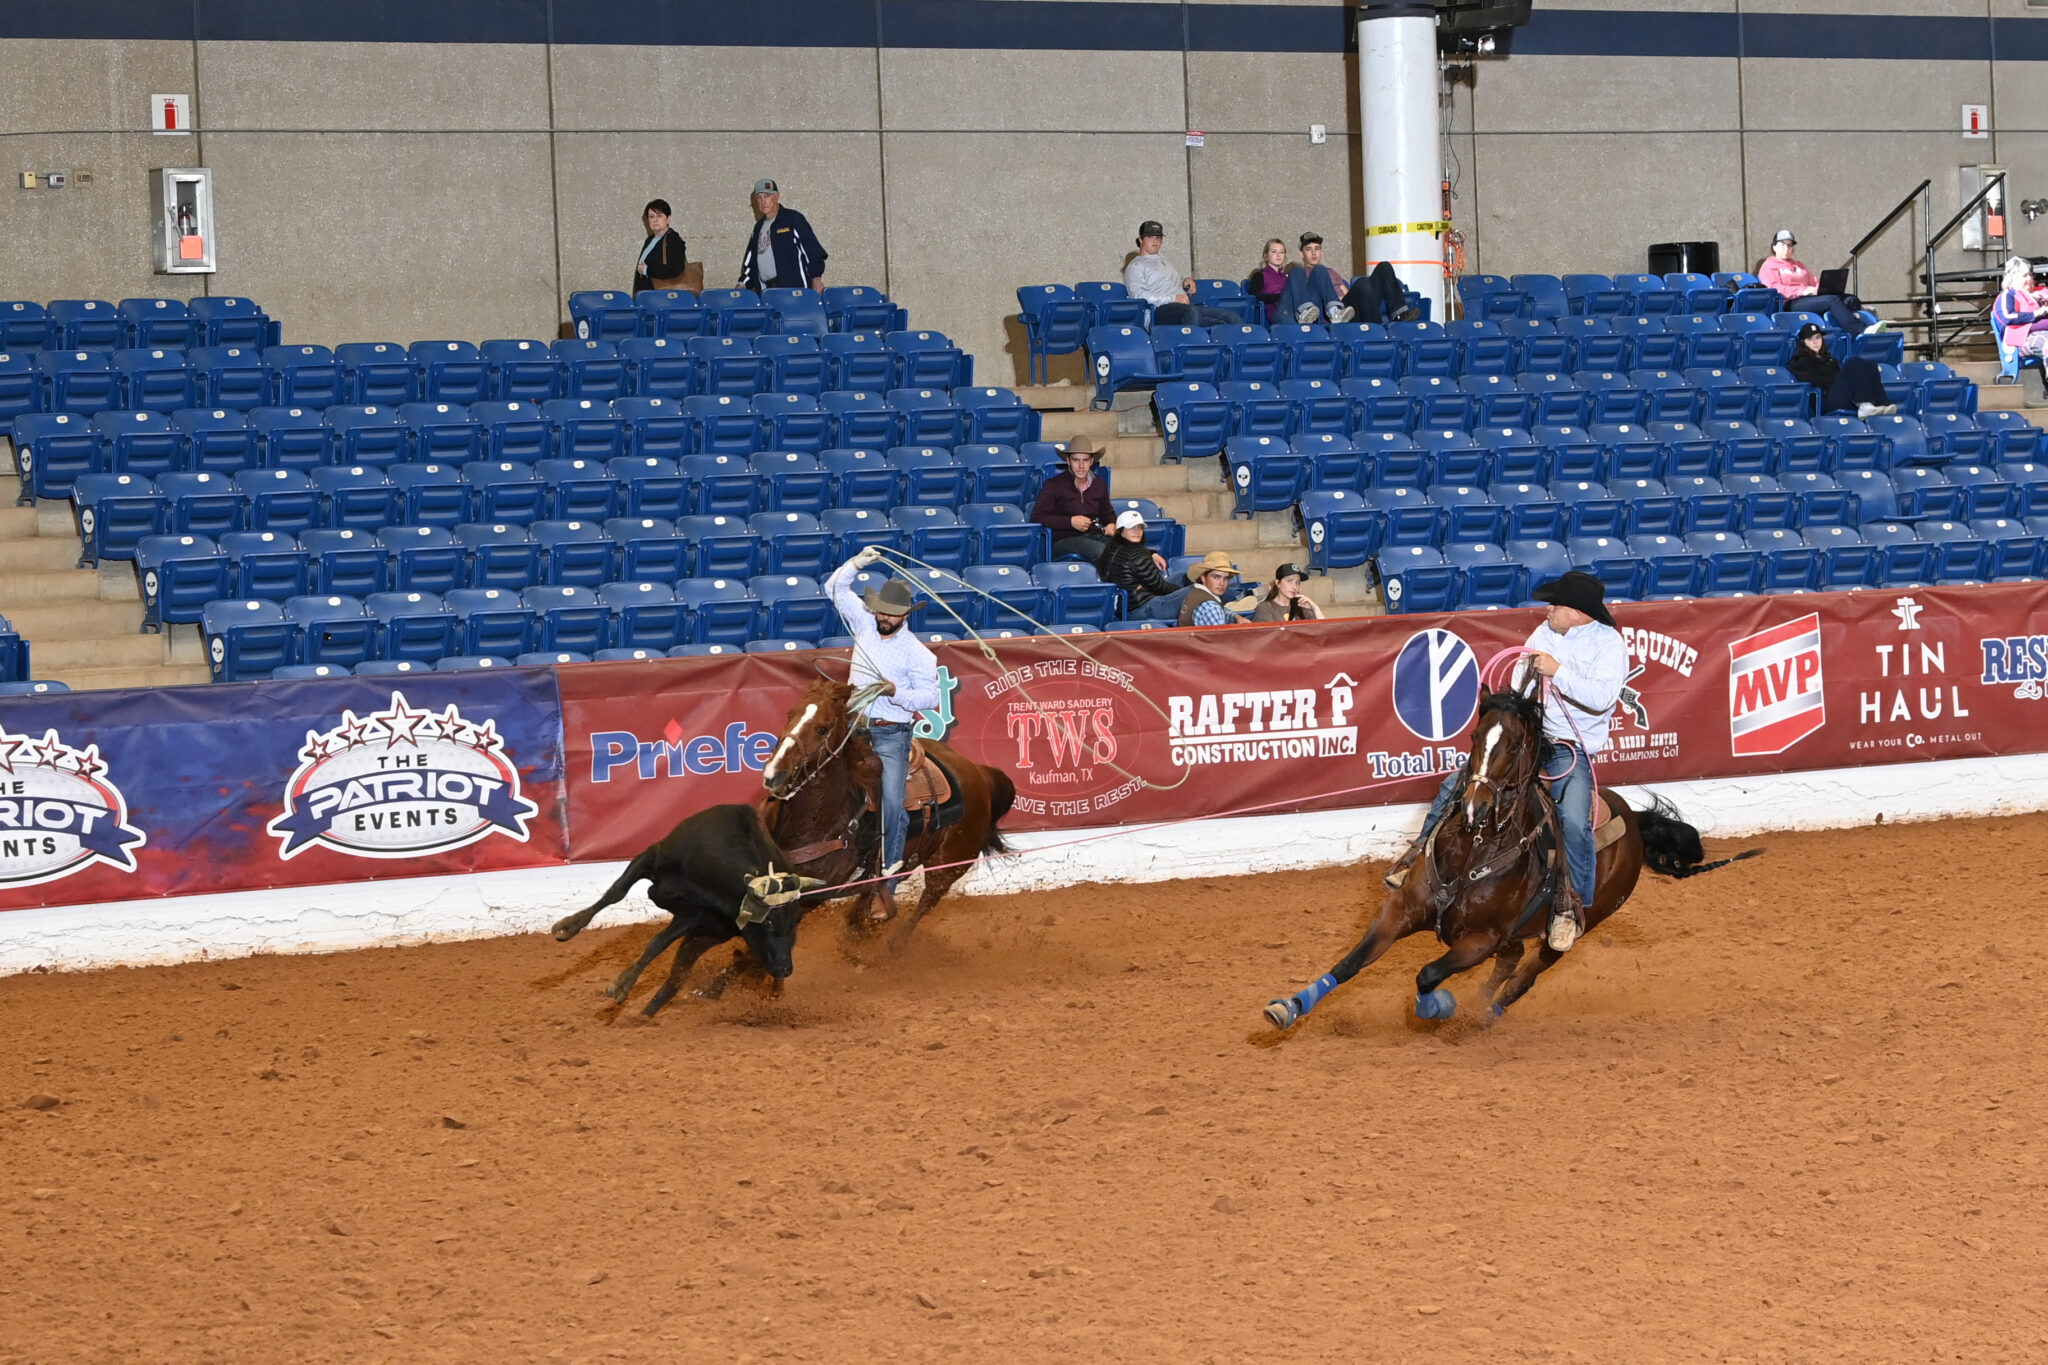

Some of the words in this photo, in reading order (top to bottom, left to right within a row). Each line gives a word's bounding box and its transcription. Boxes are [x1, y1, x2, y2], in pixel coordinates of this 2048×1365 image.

[1621, 626, 1699, 678] EQUINE
[1875, 641, 1945, 677] TIN
[1980, 635, 2048, 685] RES
[984, 665, 1034, 700] RIDE
[1035, 659, 1077, 678] THE
[1732, 649, 1820, 719] MVP
[1008, 701, 1038, 712] TRENT
[1040, 700, 1066, 711] WARD
[1067, 698, 1113, 709] SADDLERY
[1168, 688, 1318, 737] RAFTER
[1860, 685, 1969, 724] HAUL
[590, 721, 778, 783] Priefe
[1007, 707, 1118, 769] TWS
[1171, 738, 1316, 766] CONSTRUCTION
[1320, 736, 1355, 755] INC.
[1849, 740, 1875, 749] WEAR
[1878, 738, 1902, 748] YOUR
[1930, 734, 1961, 744] METAL
[1965, 732, 1982, 741] OUT
[377, 753, 428, 769] THE
[1029, 770, 1079, 785] Kaufman,
[1081, 768, 1094, 782] TX
[1367, 747, 1435, 779] Total
[1437, 746, 1471, 772] Fe
[308, 771, 504, 820] PATRIOT
[1011, 794, 1046, 815] AVE
[1050, 799, 1090, 816] THE
[0, 799, 109, 835] RIOT
[354, 807, 458, 832] EVENTS
[3, 836, 56, 858] NTS
